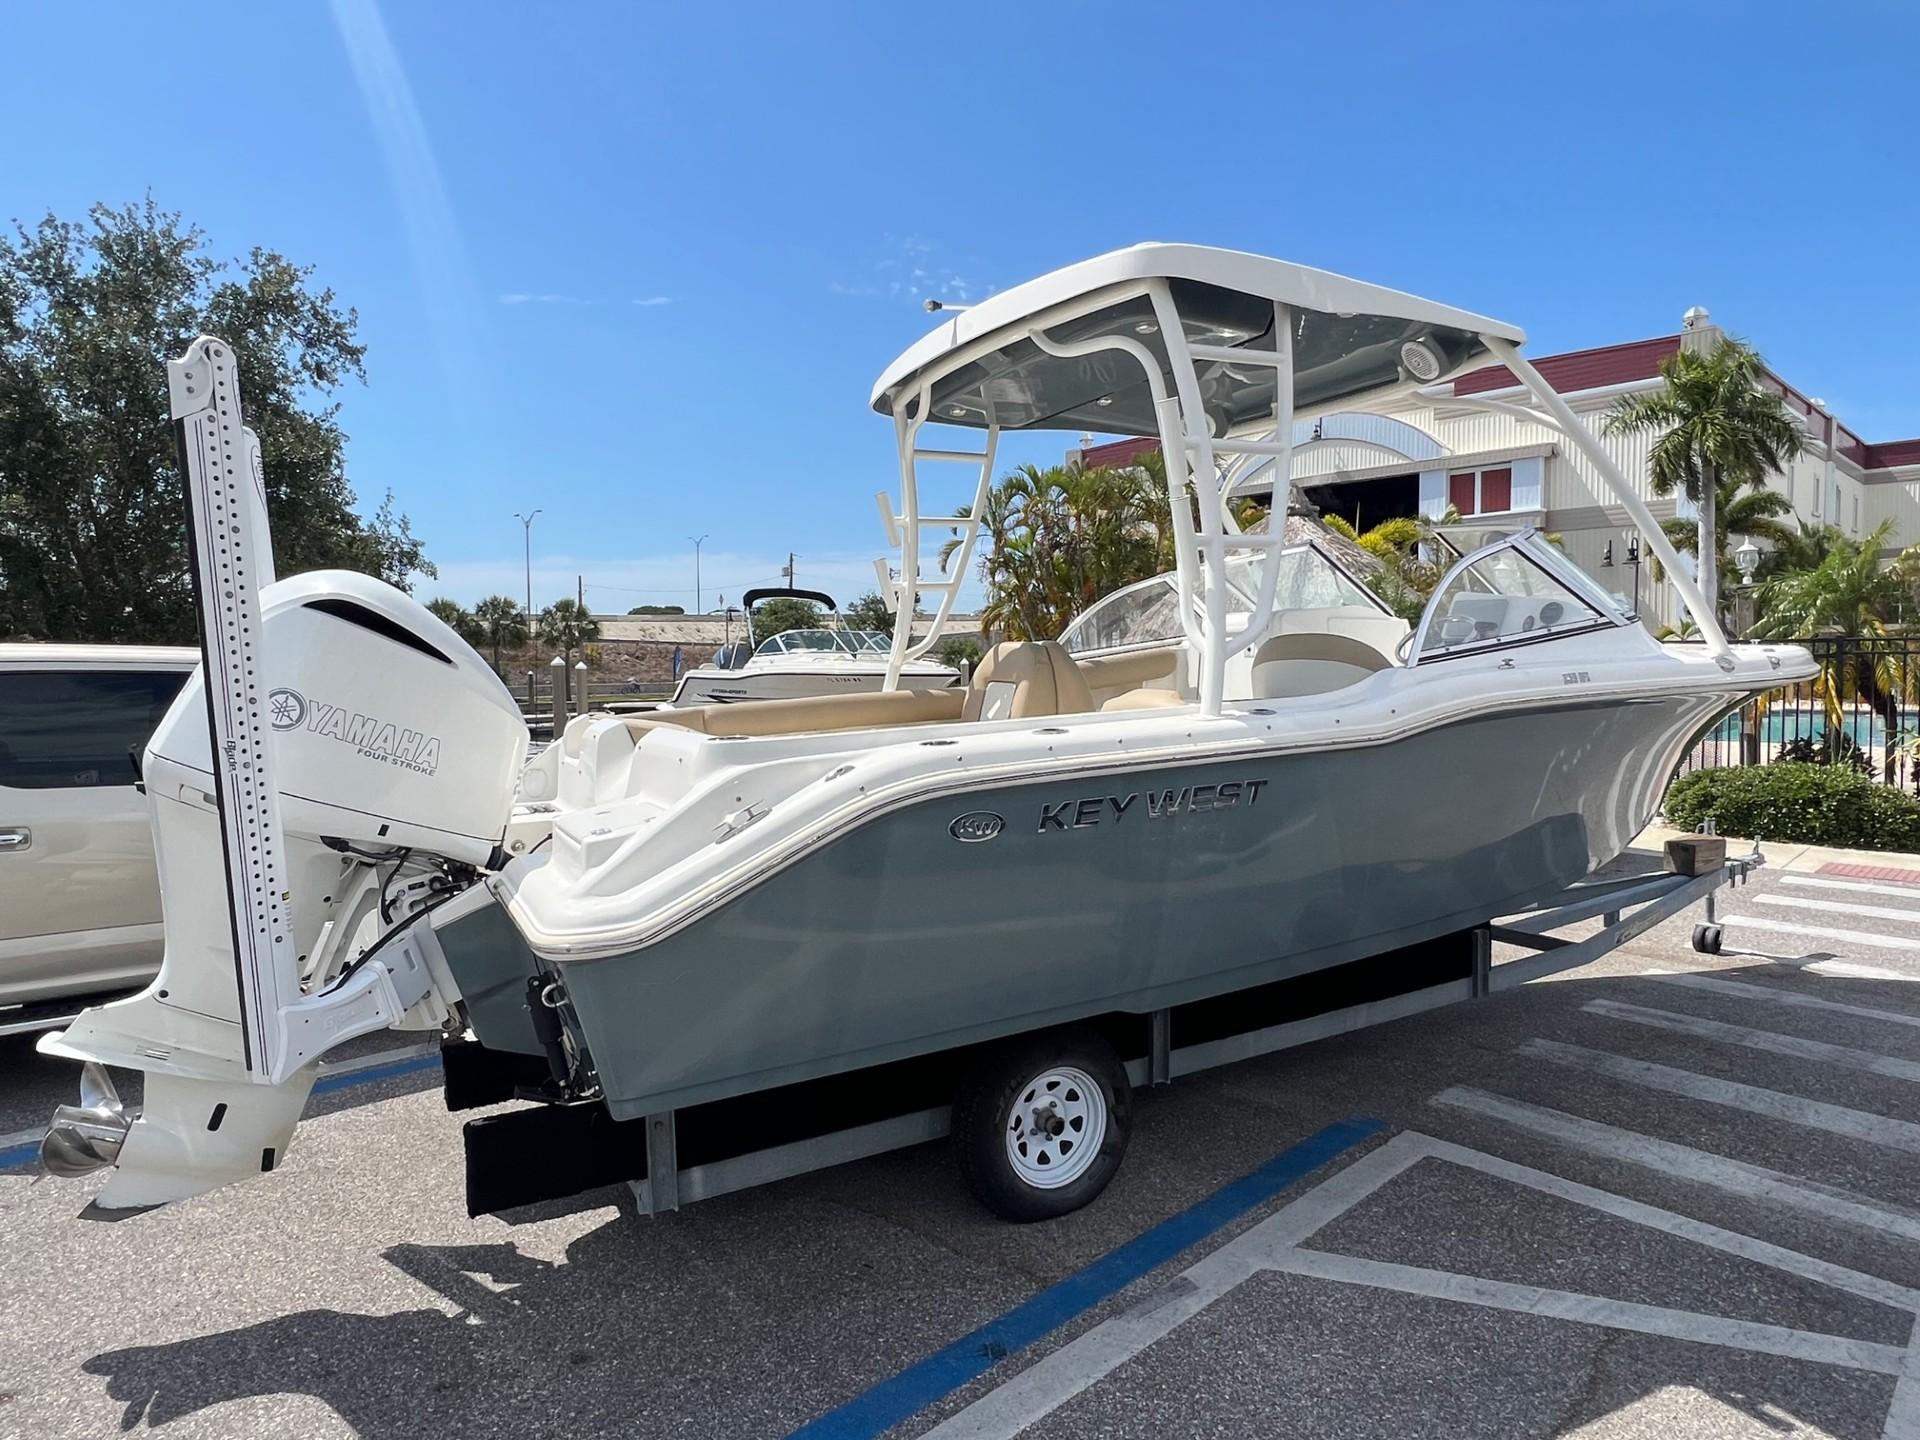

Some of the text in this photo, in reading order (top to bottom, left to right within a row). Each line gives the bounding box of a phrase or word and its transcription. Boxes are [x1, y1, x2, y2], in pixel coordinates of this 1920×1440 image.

[222, 740, 239, 772] Blade
[306, 699, 441, 770] YAMAHA
[356, 747, 436, 777] FOUR STROKE
[1037, 778, 1269, 833] KEY WEST
